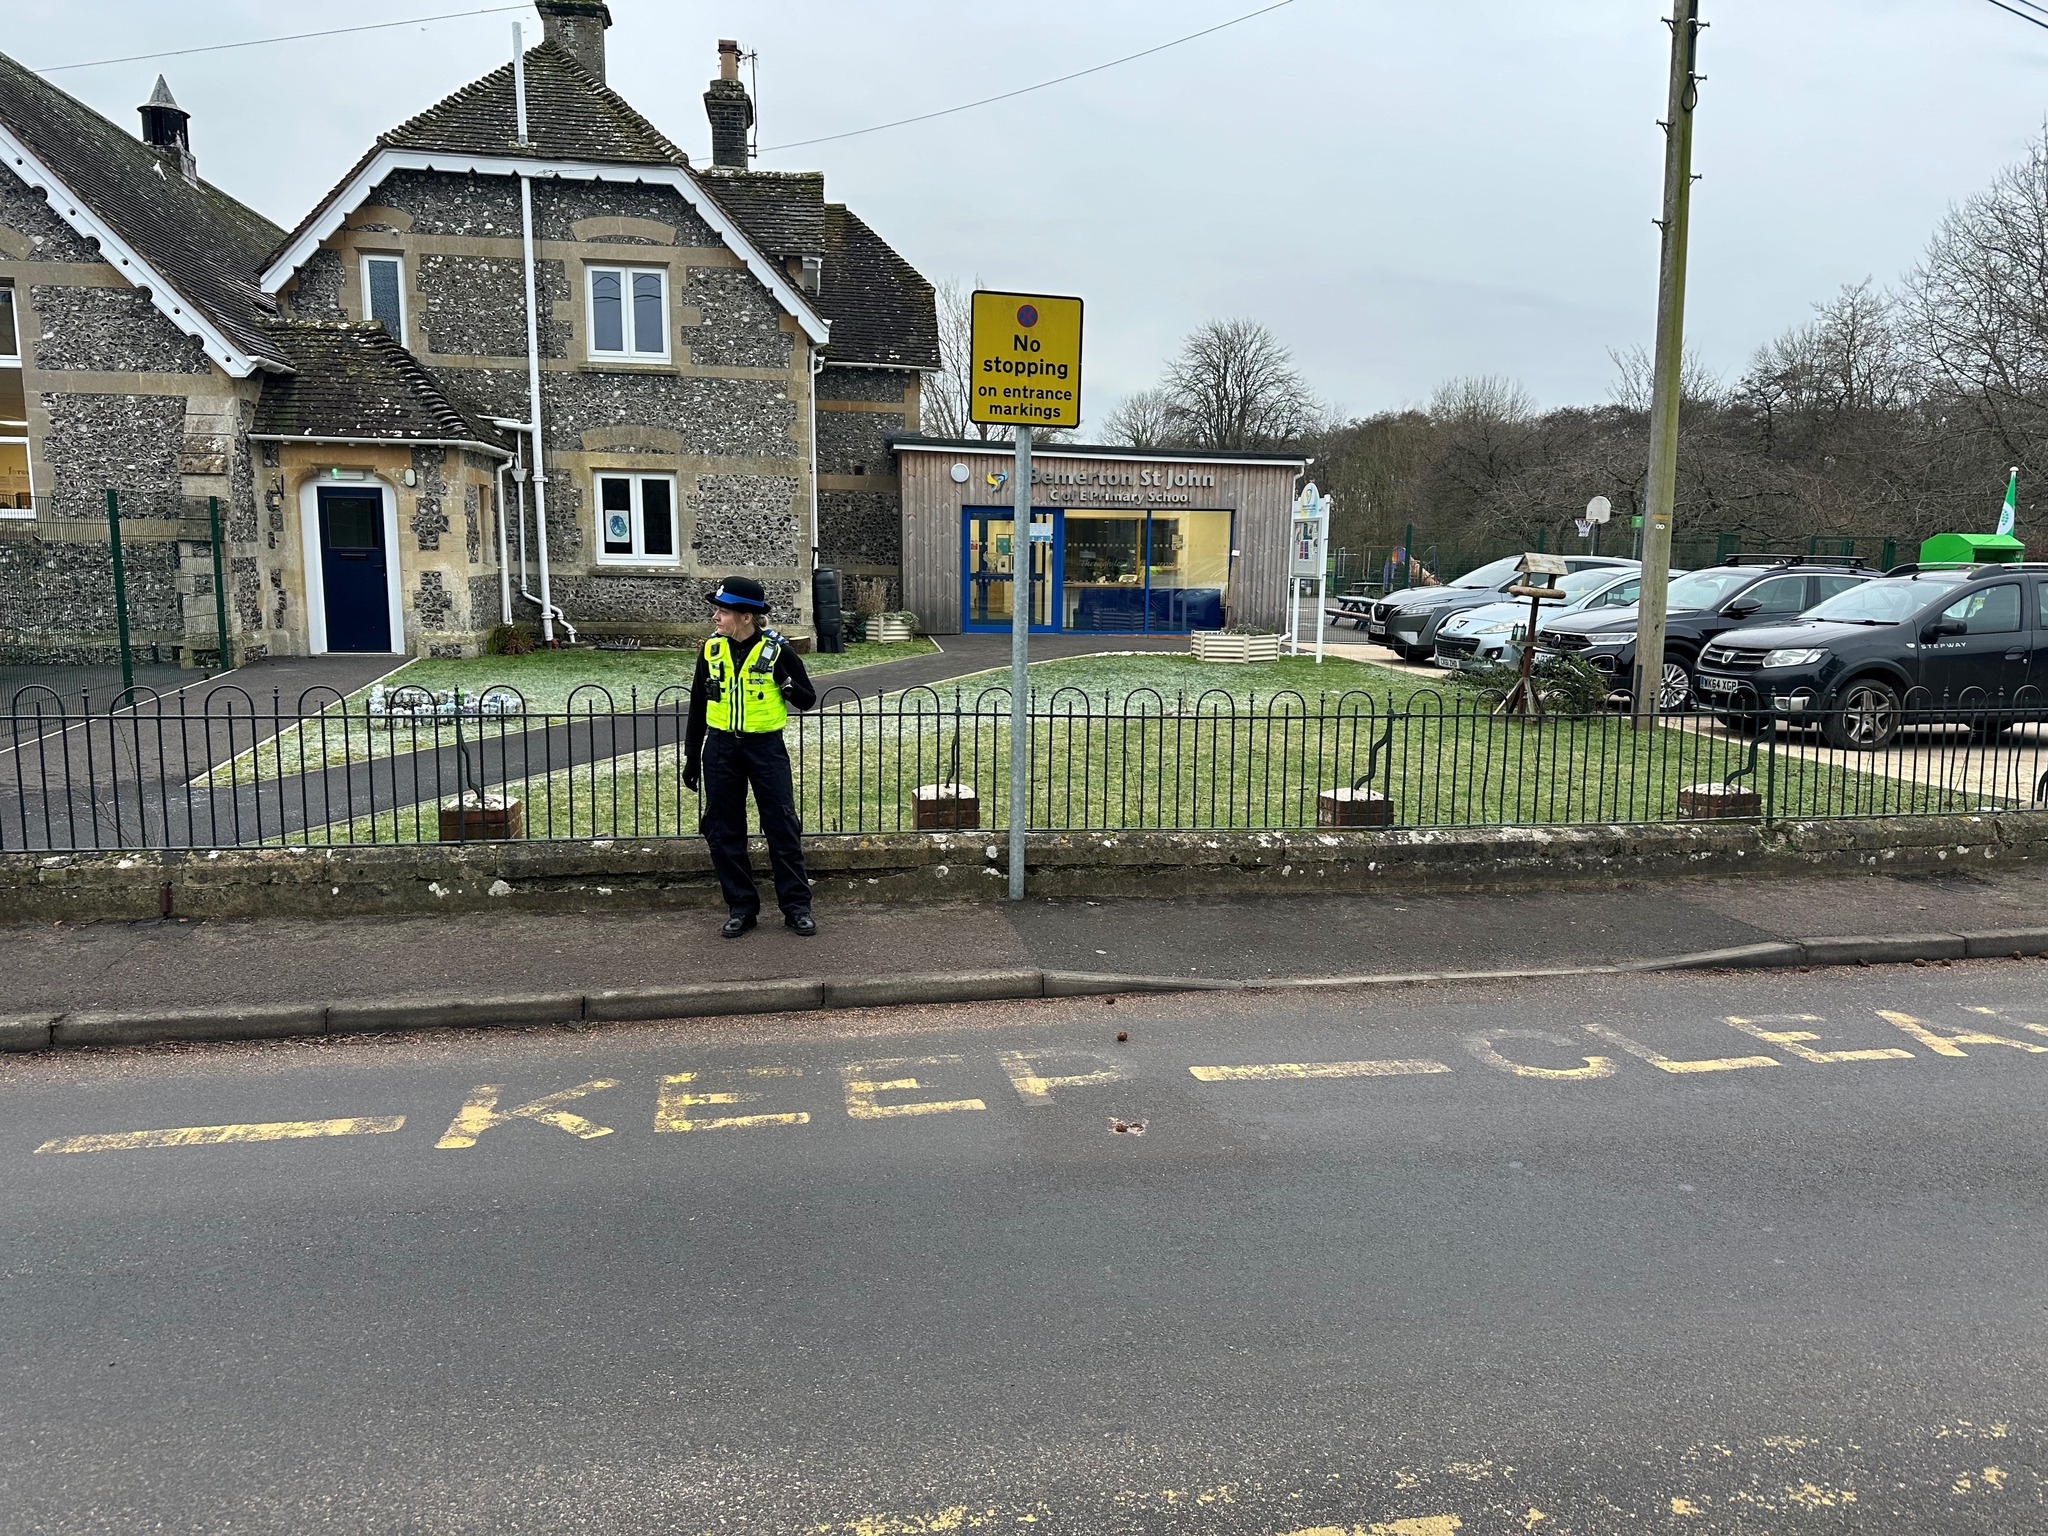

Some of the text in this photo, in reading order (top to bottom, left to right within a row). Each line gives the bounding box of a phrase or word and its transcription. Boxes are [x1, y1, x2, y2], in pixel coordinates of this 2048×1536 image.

[1013, 334, 1041, 352] No
[983, 356, 1068, 380] stopping
[978, 385, 1072, 401] on entrance
[989, 402, 1061, 420] markings
[1030, 466, 1215, 490] Bemerton St John
[1049, 489, 1192, 505] C of E Primary School
[1920, 641, 1968, 650] STEPWAY
[1722, 679, 1738, 691] XGP
[434, 1050, 1128, 1149] KEEP
